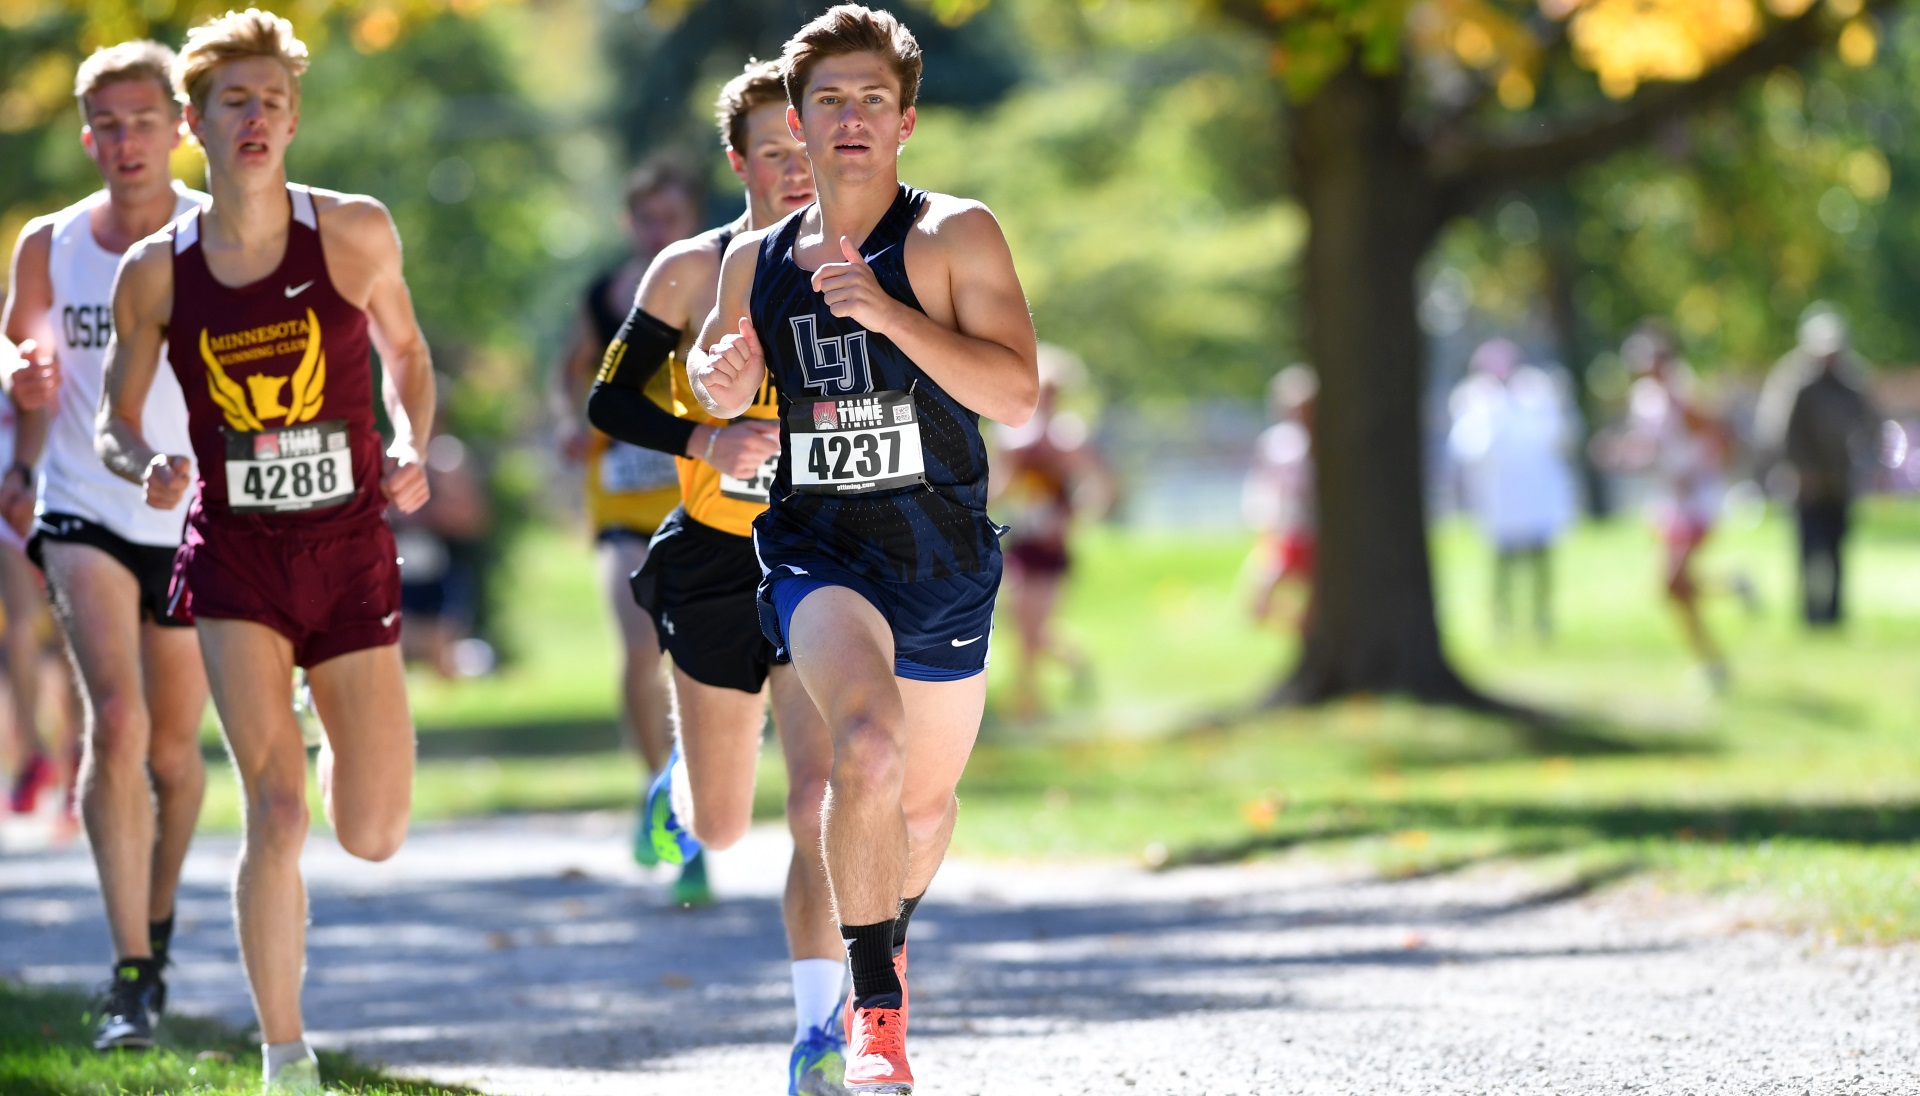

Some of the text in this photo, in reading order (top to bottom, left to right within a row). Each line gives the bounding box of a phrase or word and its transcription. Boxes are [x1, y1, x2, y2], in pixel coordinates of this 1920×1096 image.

[210, 319, 311, 352] MINNESOTA
[838, 397, 880, 408] PRIME
[837, 404, 884, 423] TIME
[840, 420, 882, 429] TIMING
[808, 430, 901, 480] 4237
[244, 457, 337, 501] 4288
[836, 481, 876, 492] pttiming.com
